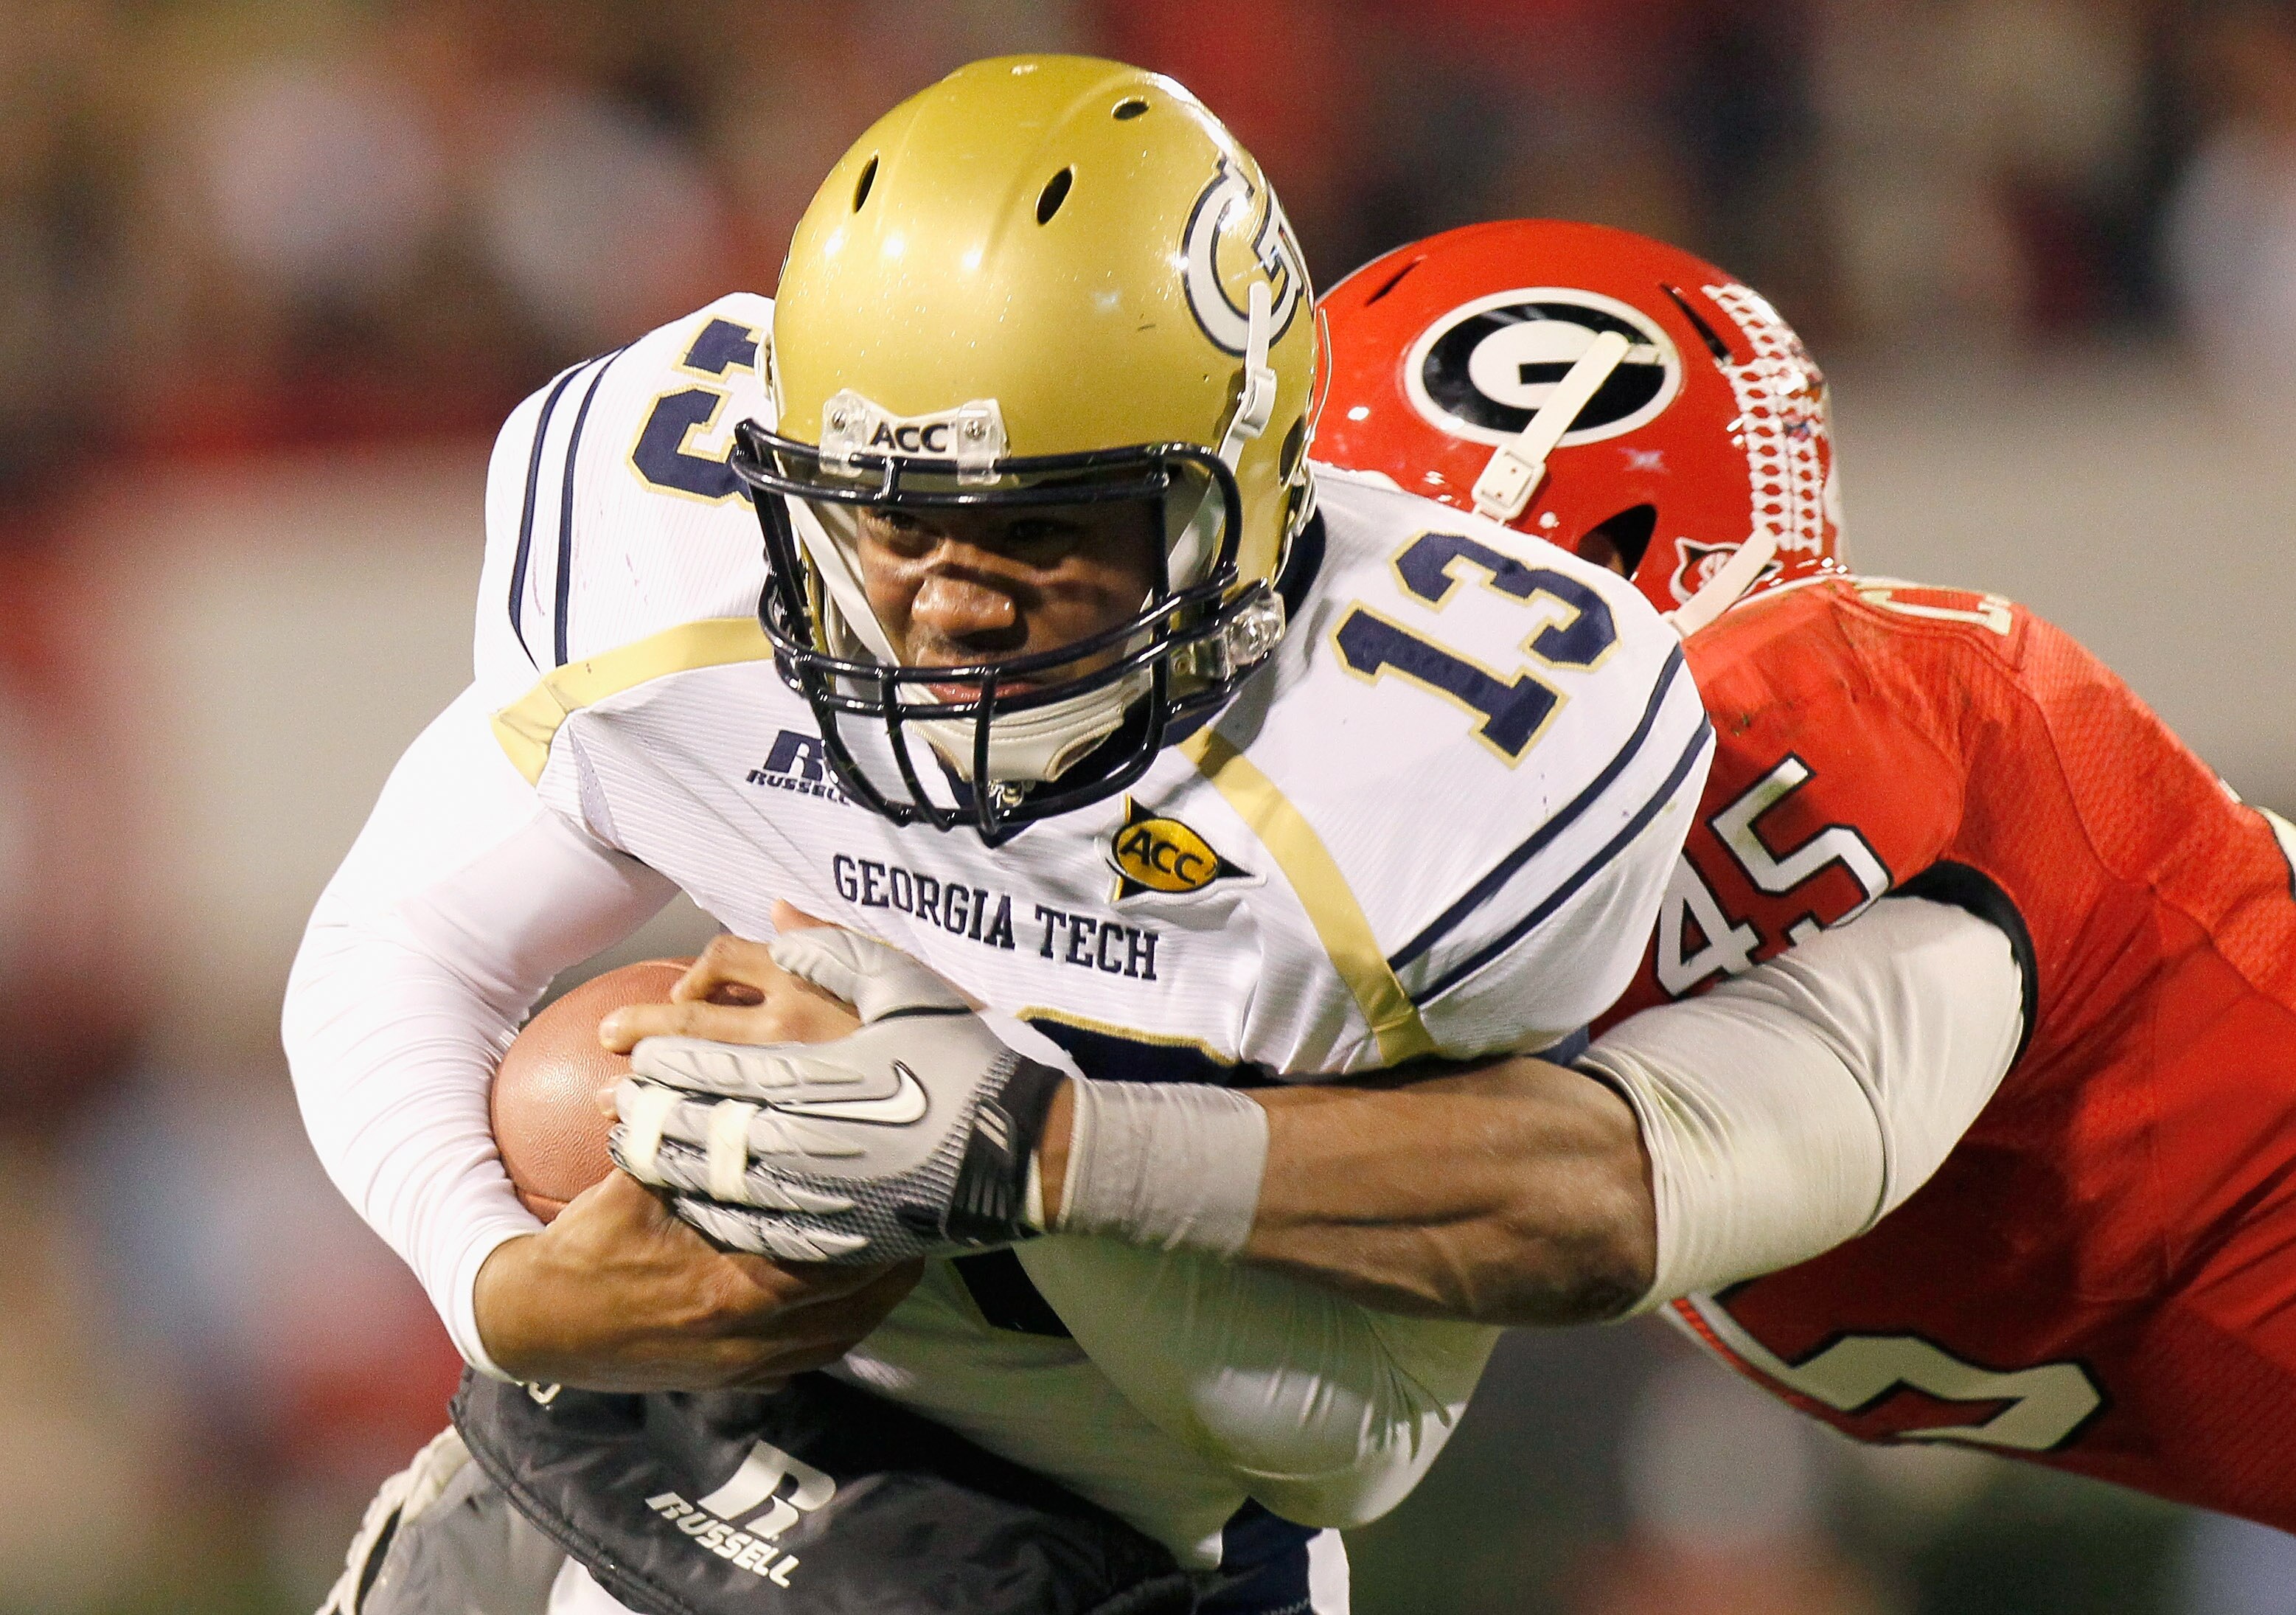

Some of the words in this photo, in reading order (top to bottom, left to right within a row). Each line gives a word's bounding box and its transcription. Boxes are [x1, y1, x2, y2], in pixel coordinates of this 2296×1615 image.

[868, 421, 950, 453] ACC
[1329, 528, 1622, 770] 13
[1119, 828, 1204, 885] ACC
[1654, 750, 1896, 1003] 45
[832, 852, 1016, 951] GEORGIA
[1034, 903, 1159, 981] TECH
[644, 1491, 801, 1589] RUSSELL
[697, 1439, 837, 1541] R
